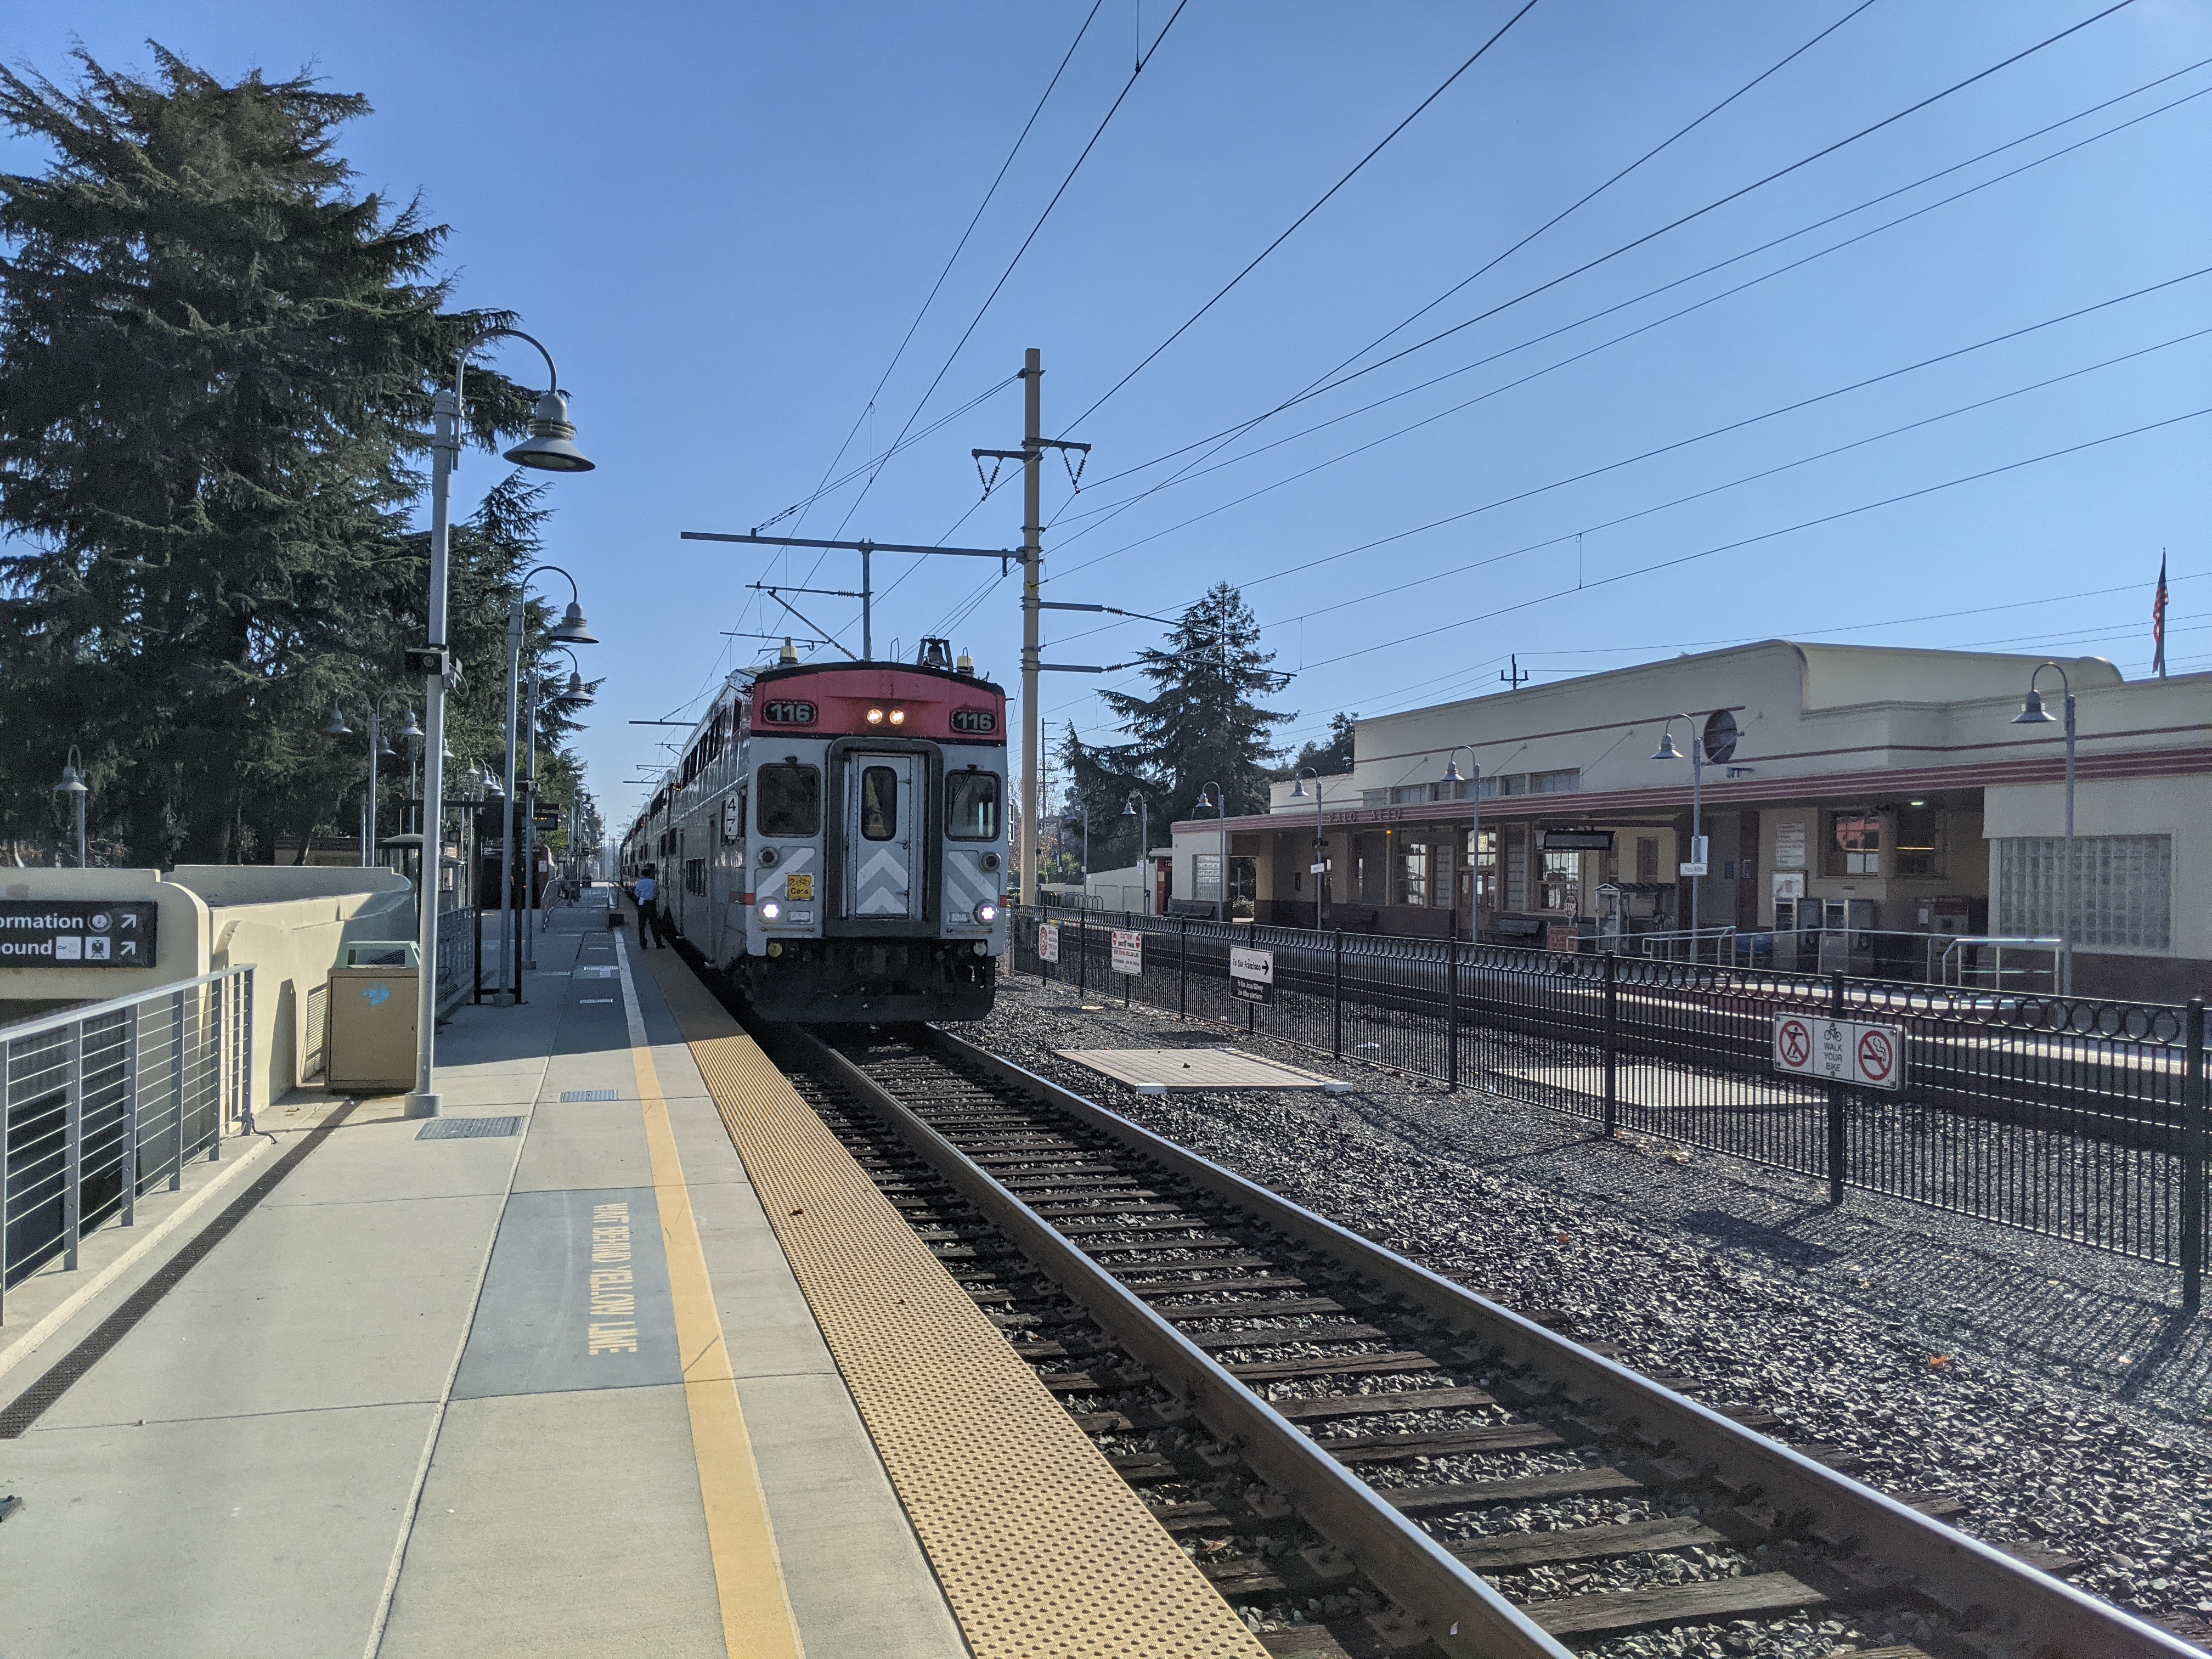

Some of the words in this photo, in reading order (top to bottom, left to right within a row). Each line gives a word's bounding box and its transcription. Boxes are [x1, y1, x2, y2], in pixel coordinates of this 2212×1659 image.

[770, 704, 810, 723] 116
[957, 713, 991, 730] 116
[1328, 812, 1356, 823] PALO
[1372, 808, 1401, 820] ALTO
[1565, 902, 1576, 911] STOP
[0, 939, 52, 955] ound
[1233, 958, 1237, 966] To
[1244, 960, 1261, 971] Francisco
[1824, 1042, 1842, 1052] WALK
[1824, 1052, 1842, 1062] YOUR
[1826, 1062, 1841, 1071] BIKE
[593, 1203, 630, 1223] WAIT
[591, 1226, 631, 1262] BEHIND
[590, 1265, 635, 1315] YELLOW
[588, 1321, 639, 1356] LINE
